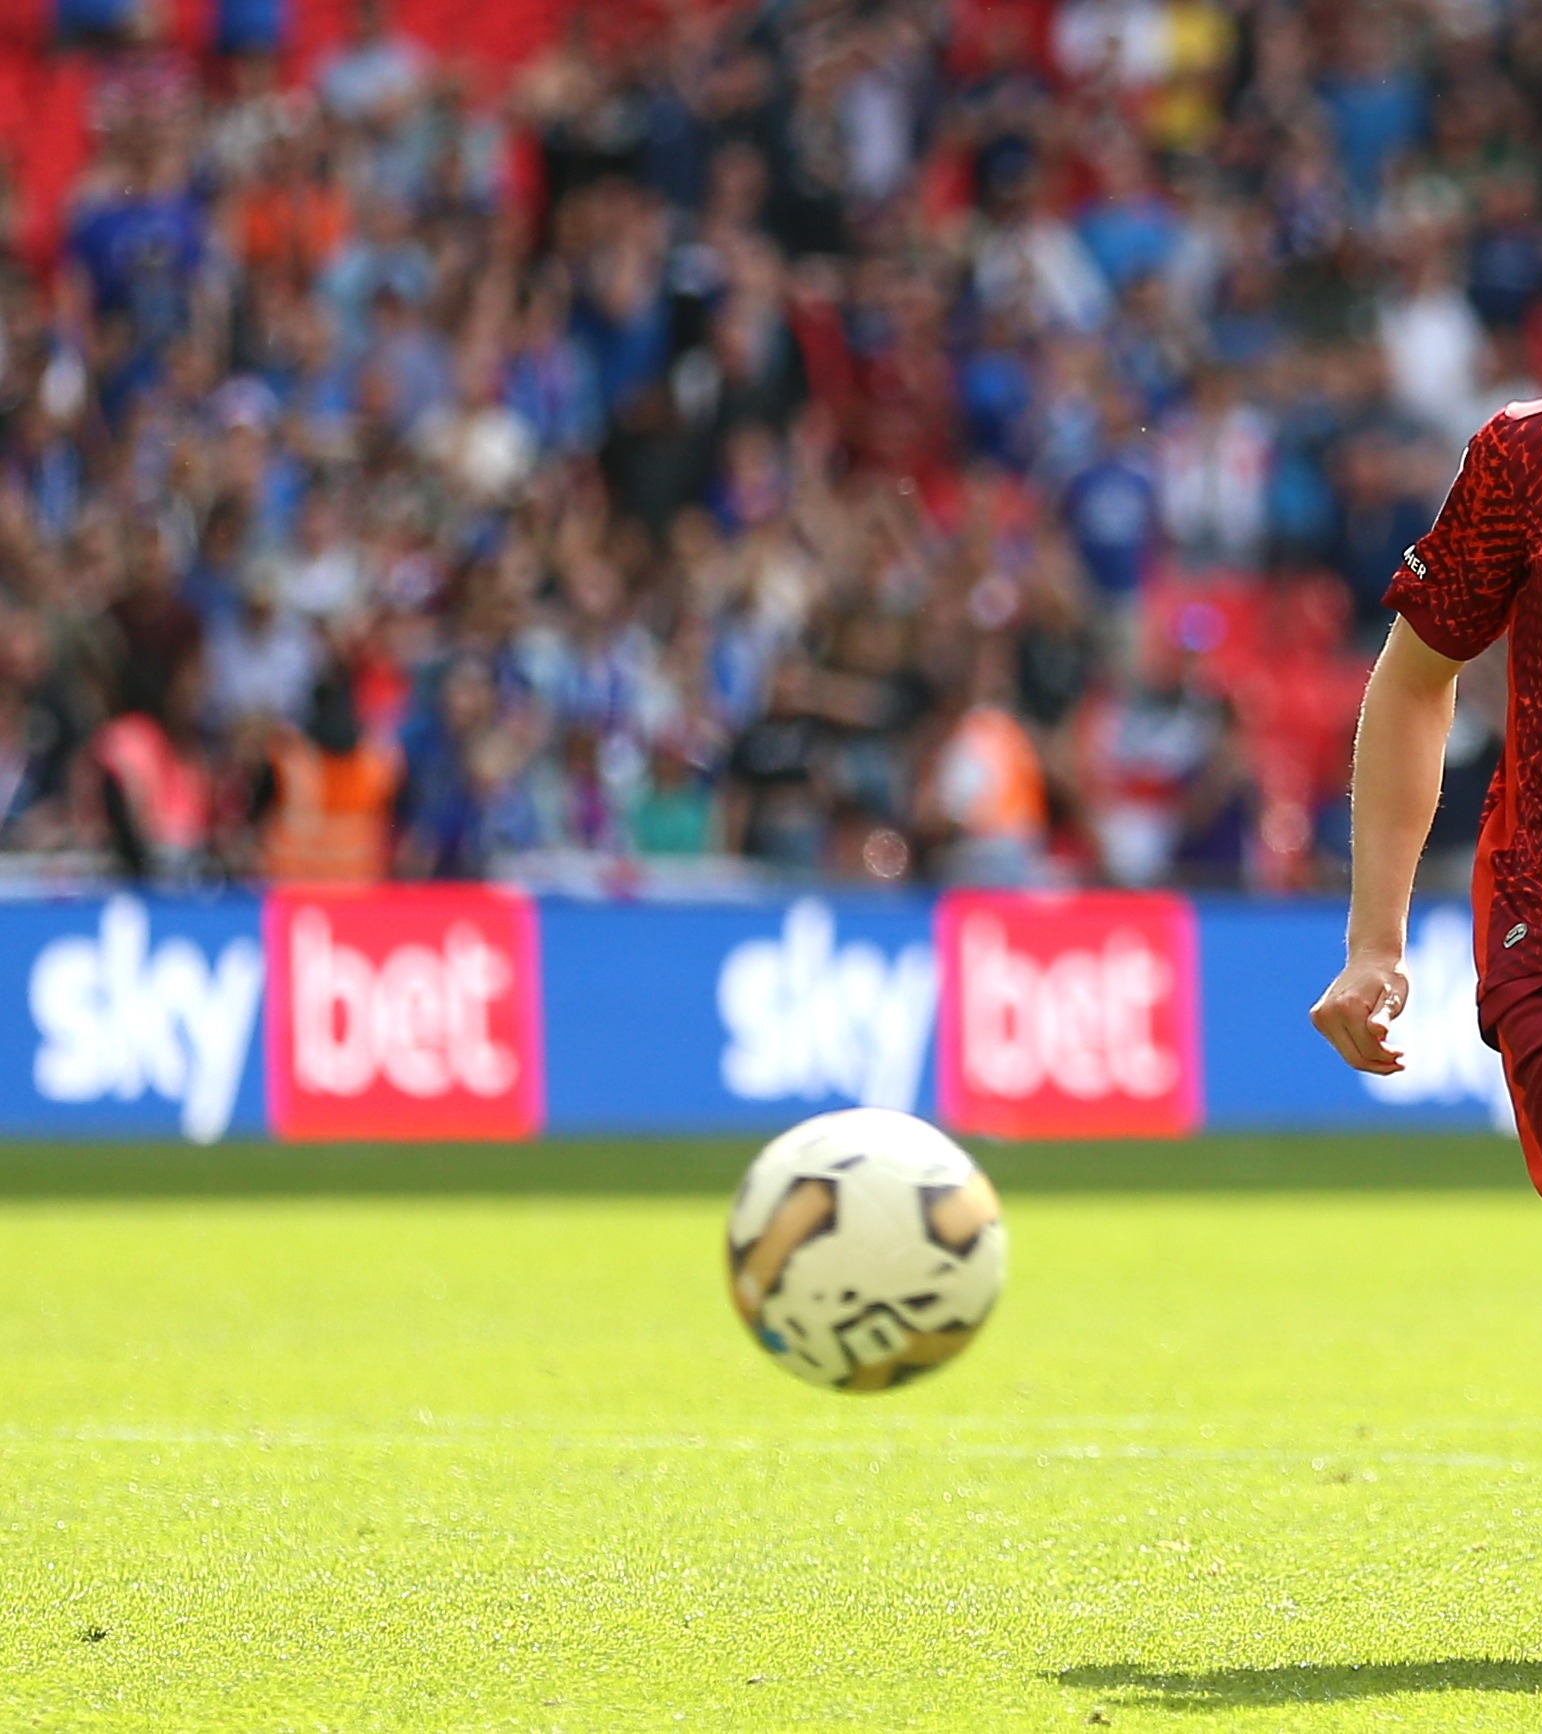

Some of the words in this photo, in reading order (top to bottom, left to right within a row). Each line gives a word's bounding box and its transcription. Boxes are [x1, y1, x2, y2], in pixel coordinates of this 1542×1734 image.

[28, 893, 264, 1144] sky
[290, 906, 518, 1098] bet
[716, 896, 940, 1115] sky
[961, 909, 1180, 1098] bet
